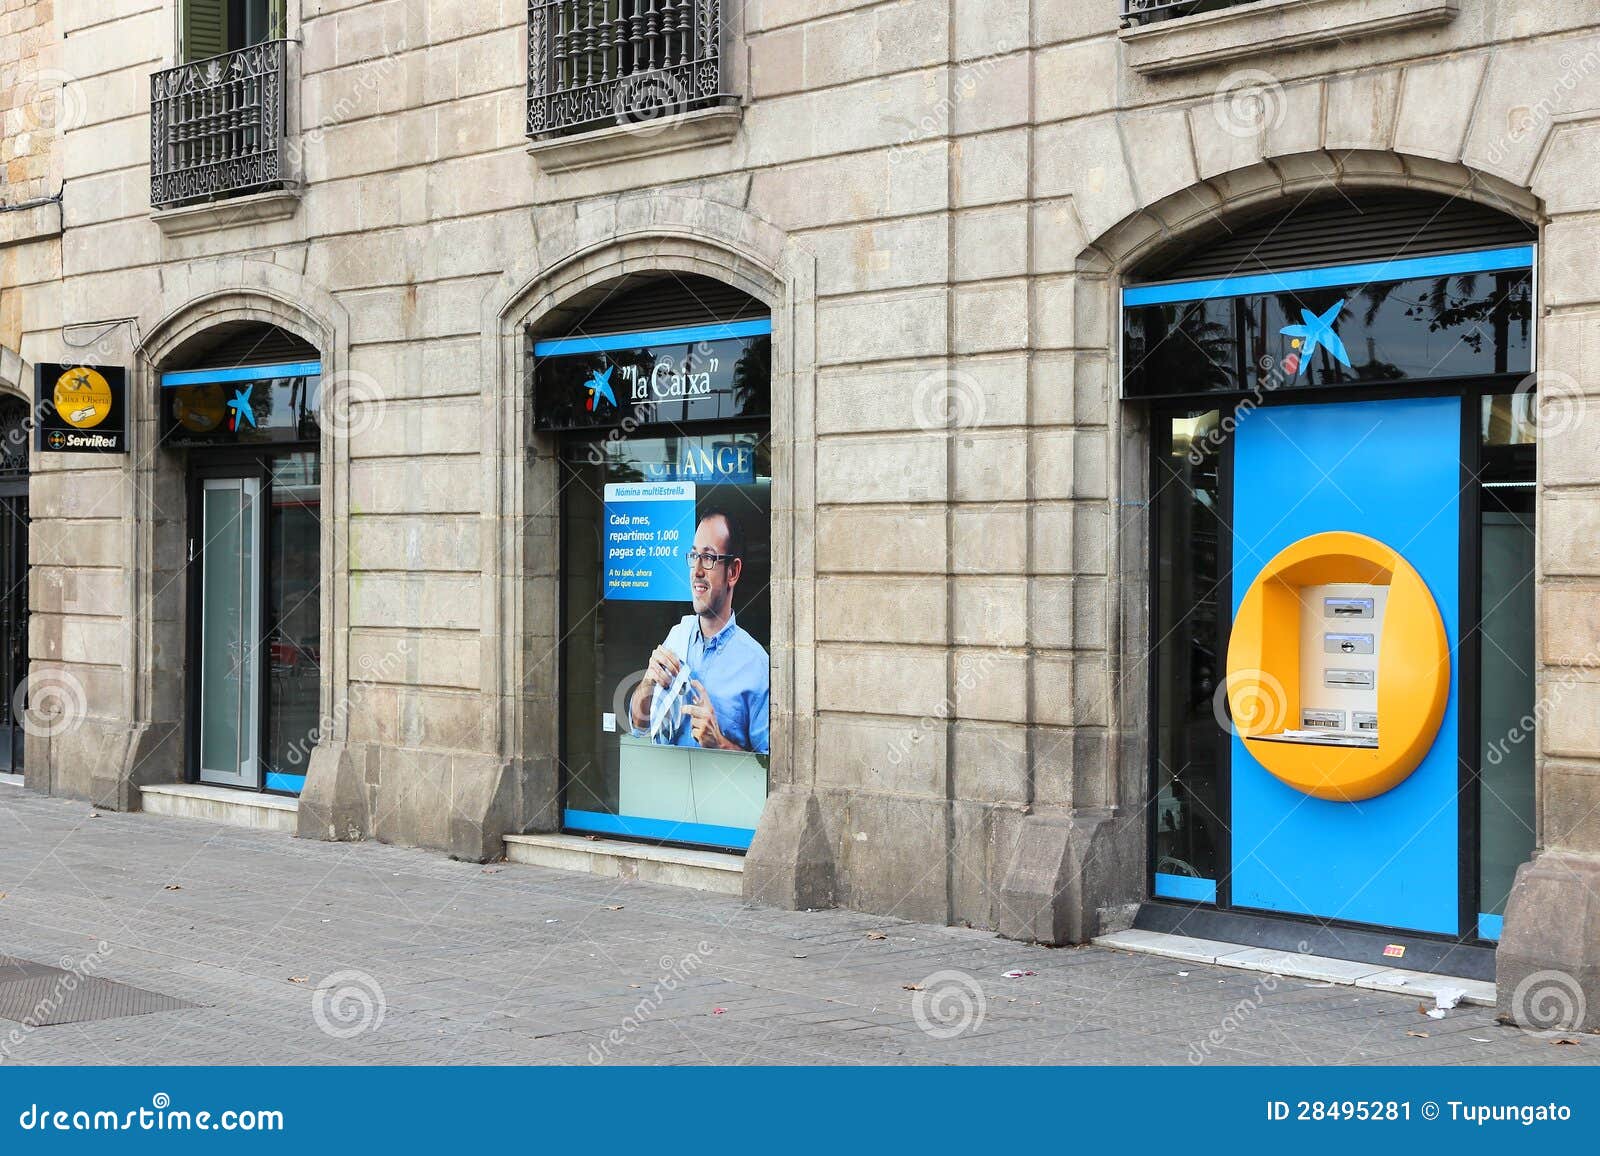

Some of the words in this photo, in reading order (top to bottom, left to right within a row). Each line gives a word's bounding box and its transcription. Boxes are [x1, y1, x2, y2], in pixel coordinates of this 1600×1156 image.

[66, 434, 117, 447] ServiRed
[615, 488, 640, 497] Nómina
[642, 486, 685, 496] multiEstrella
[609, 514, 630, 525] Cada
[632, 516, 650, 526] mes,
[609, 530, 654, 543] repartimos
[656, 530, 679, 541] 1.000
[609, 547, 634, 559] pagas
[636, 546, 647, 557] de
[648, 546, 671, 557] 1.000
[672, 546, 679, 557] €
[609, 569, 614, 577] A
[615, 569, 621, 577] tu
[621, 568, 635, 578] lado,
[636, 568, 653, 577] ahora
[621, 581, 632, 589] que
